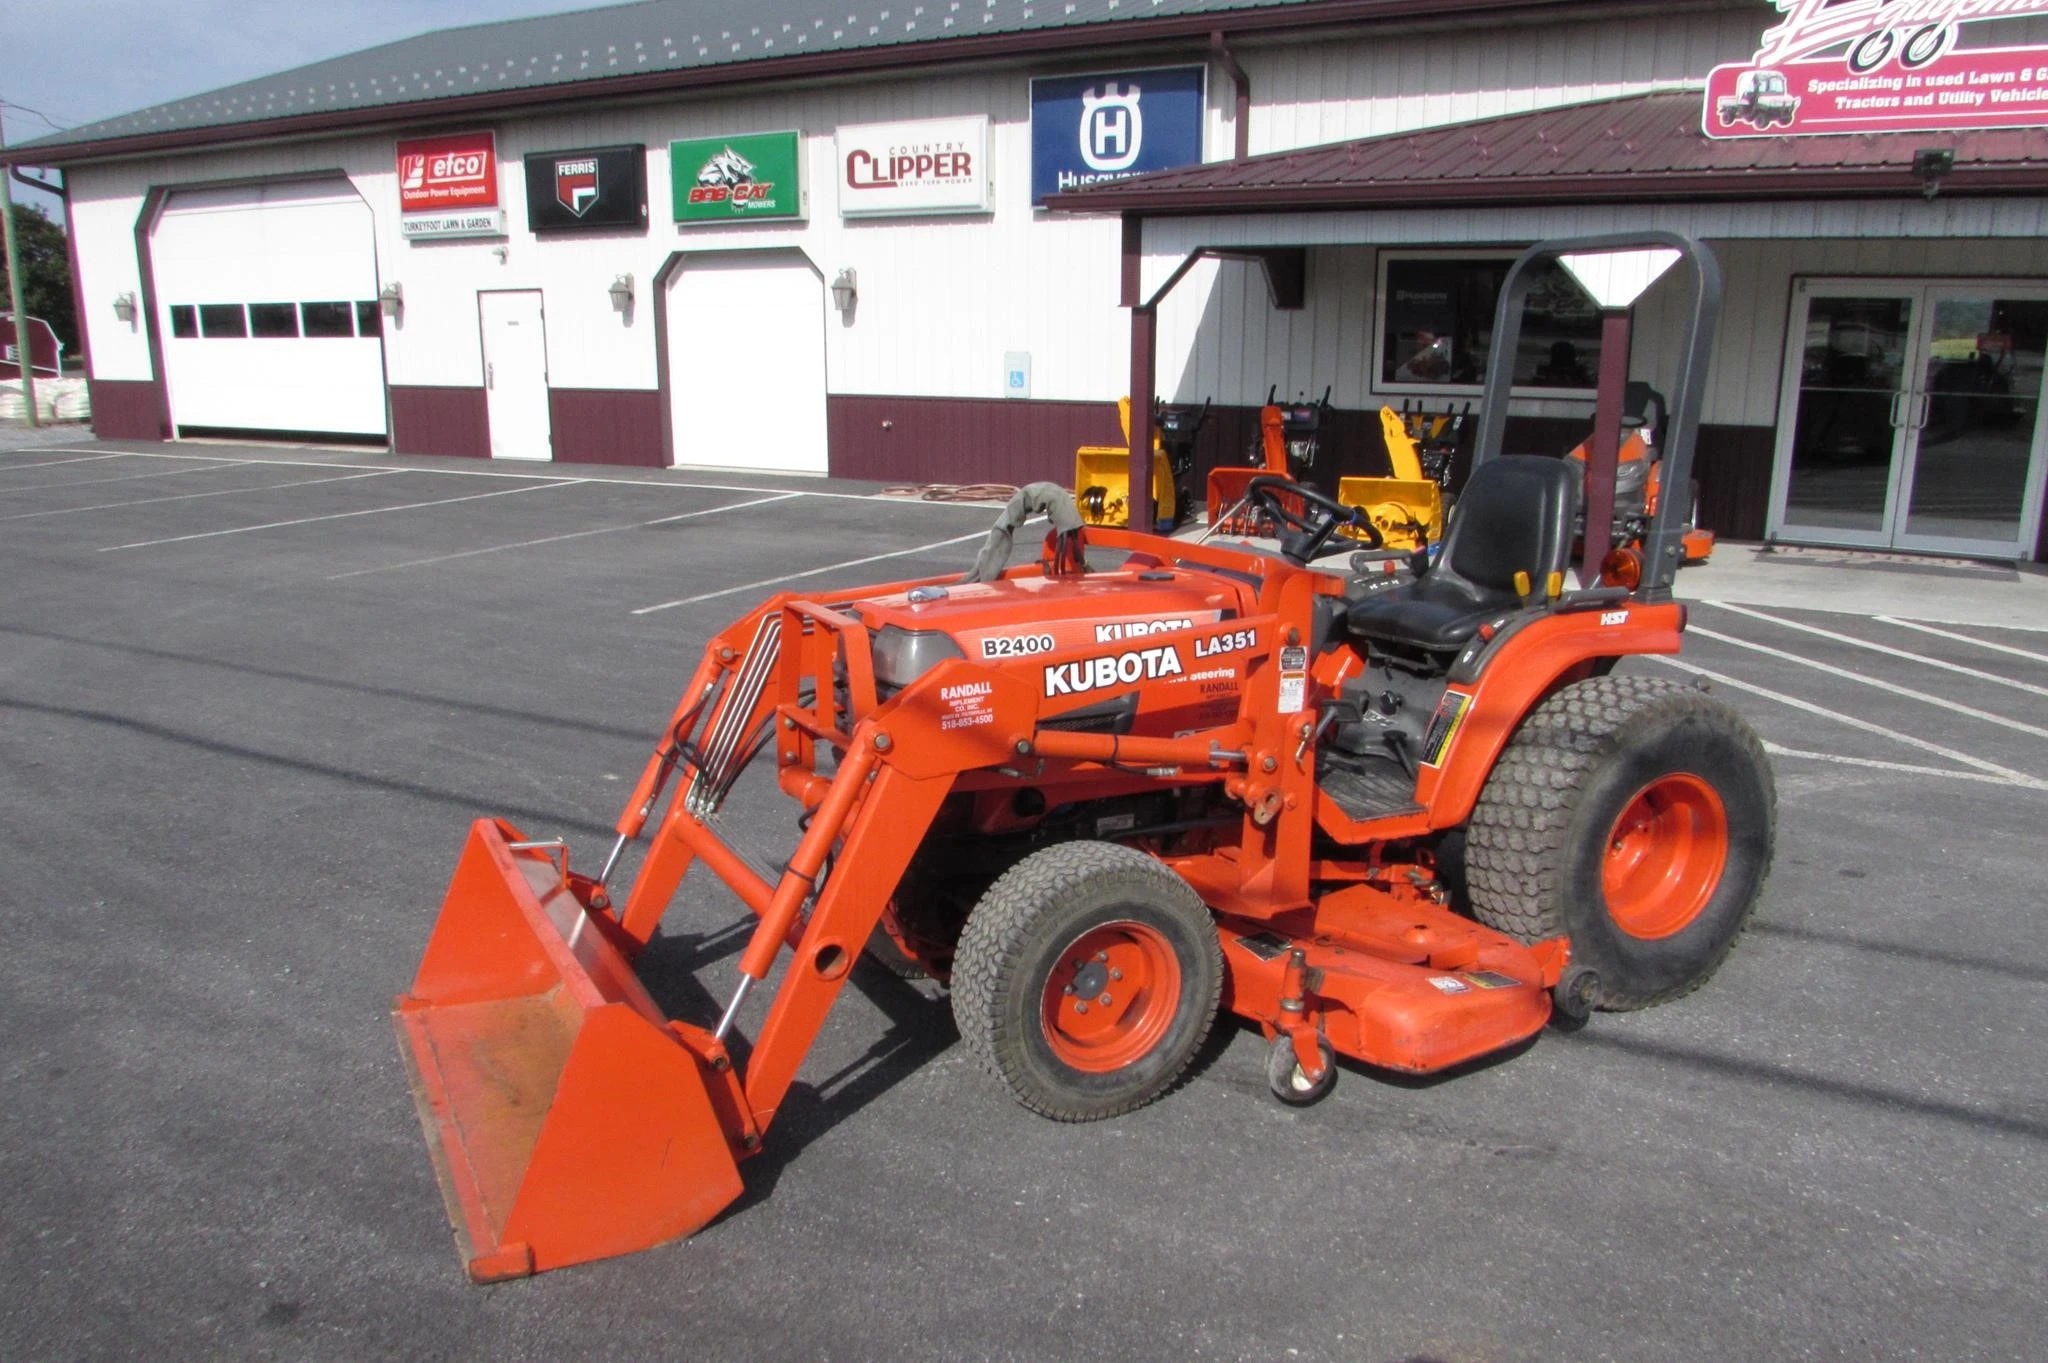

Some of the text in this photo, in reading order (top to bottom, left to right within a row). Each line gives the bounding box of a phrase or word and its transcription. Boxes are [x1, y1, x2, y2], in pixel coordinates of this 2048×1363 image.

[1808, 75, 1903, 94] Specializing
[1906, 75, 1922, 87] in
[1925, 72, 1965, 86] used
[1968, 70, 2015, 84] Lawn
[1835, 95, 1901, 109] Tractors
[1904, 92, 1934, 106] and
[1938, 90, 1985, 106] Utility
[889, 141, 964, 156] COUNTRY
[433, 153, 480, 177] efco
[559, 162, 595, 176] FERRIS
[846, 149, 972, 190] CLIPPER
[403, 186, 487, 199] Outdoor Power Equipment
[403, 221, 441, 232] TURKEYFOOT
[442, 220, 460, 230] LAWN
[467, 218, 492, 229] GARDEN
[983, 634, 1055, 658] B2400
[1195, 629, 1256, 658] LA351
[1045, 646, 1182, 698] KUBOTA
[941, 681, 992, 700] RANDALL
